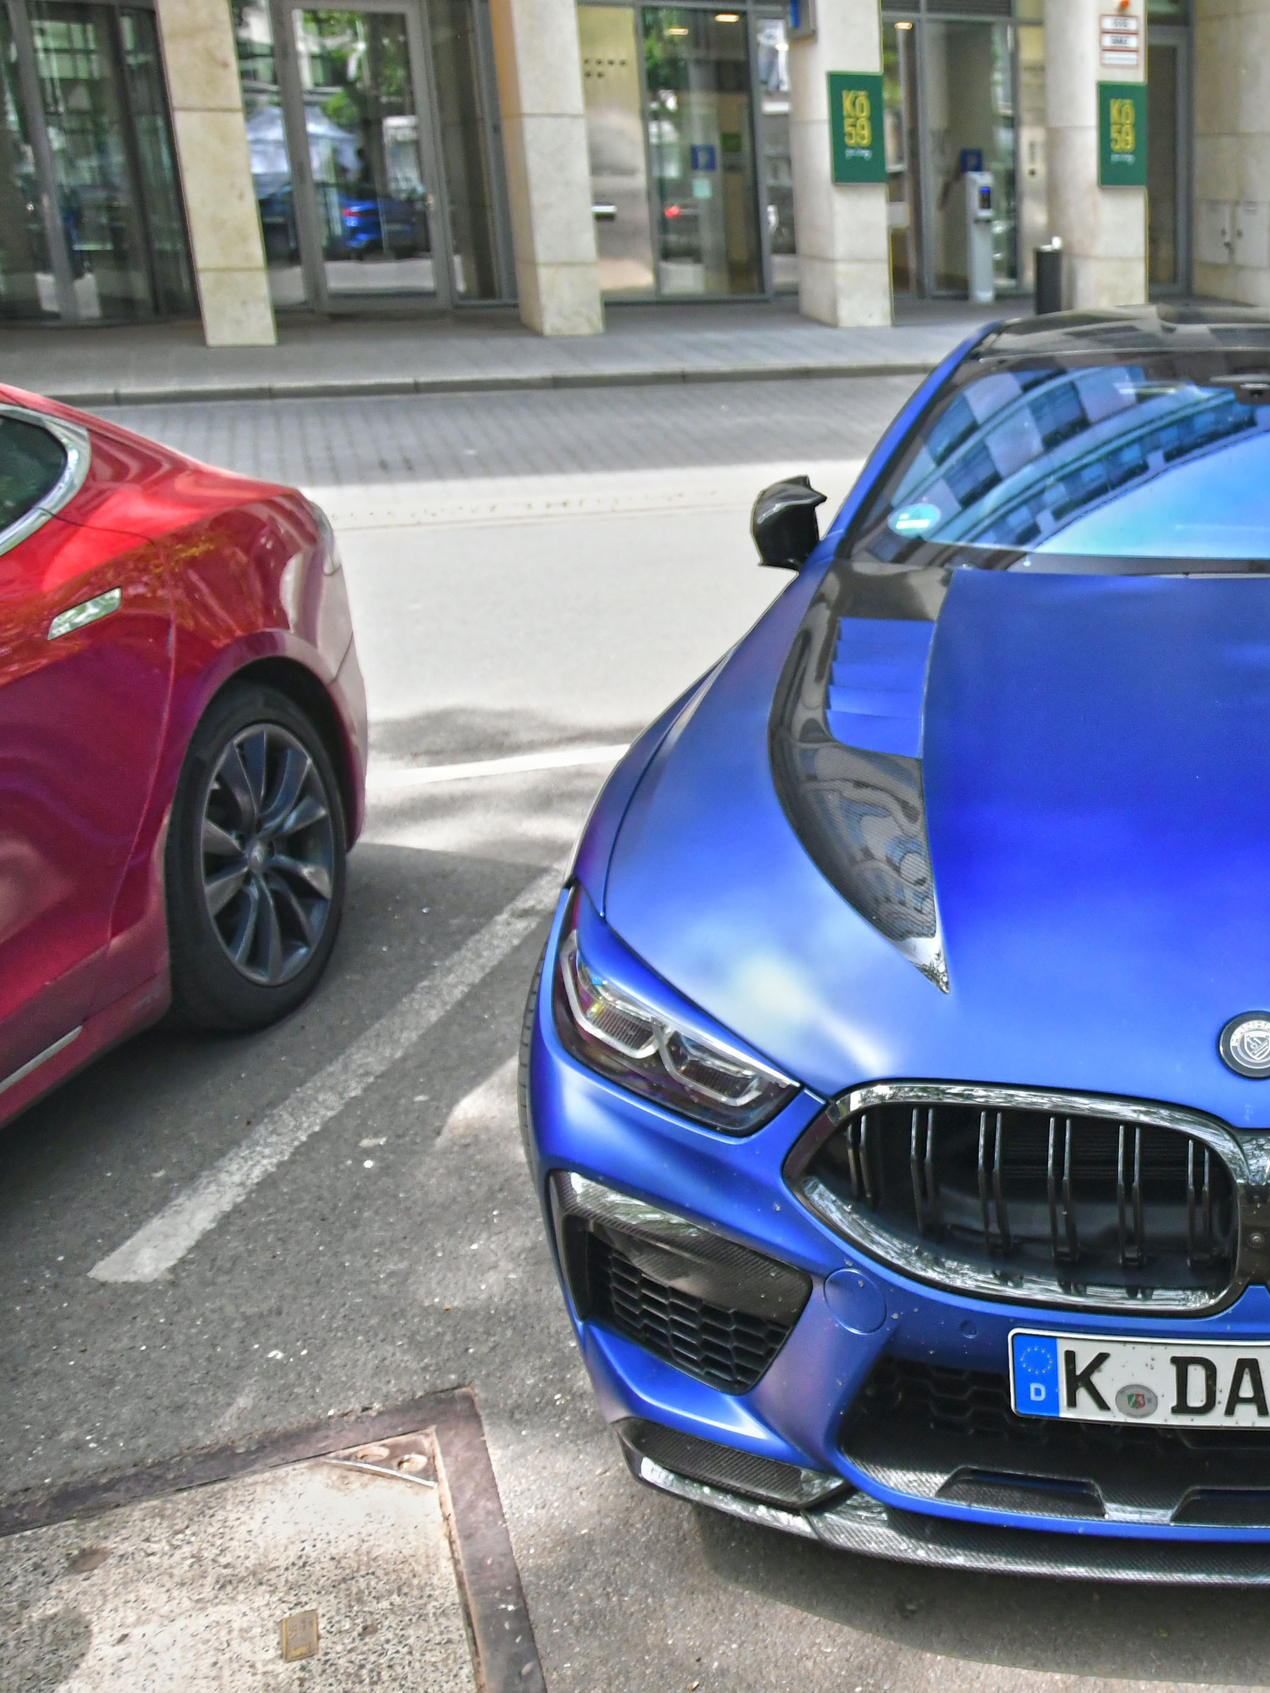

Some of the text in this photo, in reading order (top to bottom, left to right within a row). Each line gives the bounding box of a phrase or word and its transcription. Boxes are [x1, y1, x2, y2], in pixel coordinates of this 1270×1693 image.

[844, 117, 873, 148] 59
[1110, 124, 1136, 153] 59
[1030, 1383, 1046, 1402] D
[1063, 1349, 1111, 1413] K
[1169, 1355, 1270, 1418] DA
